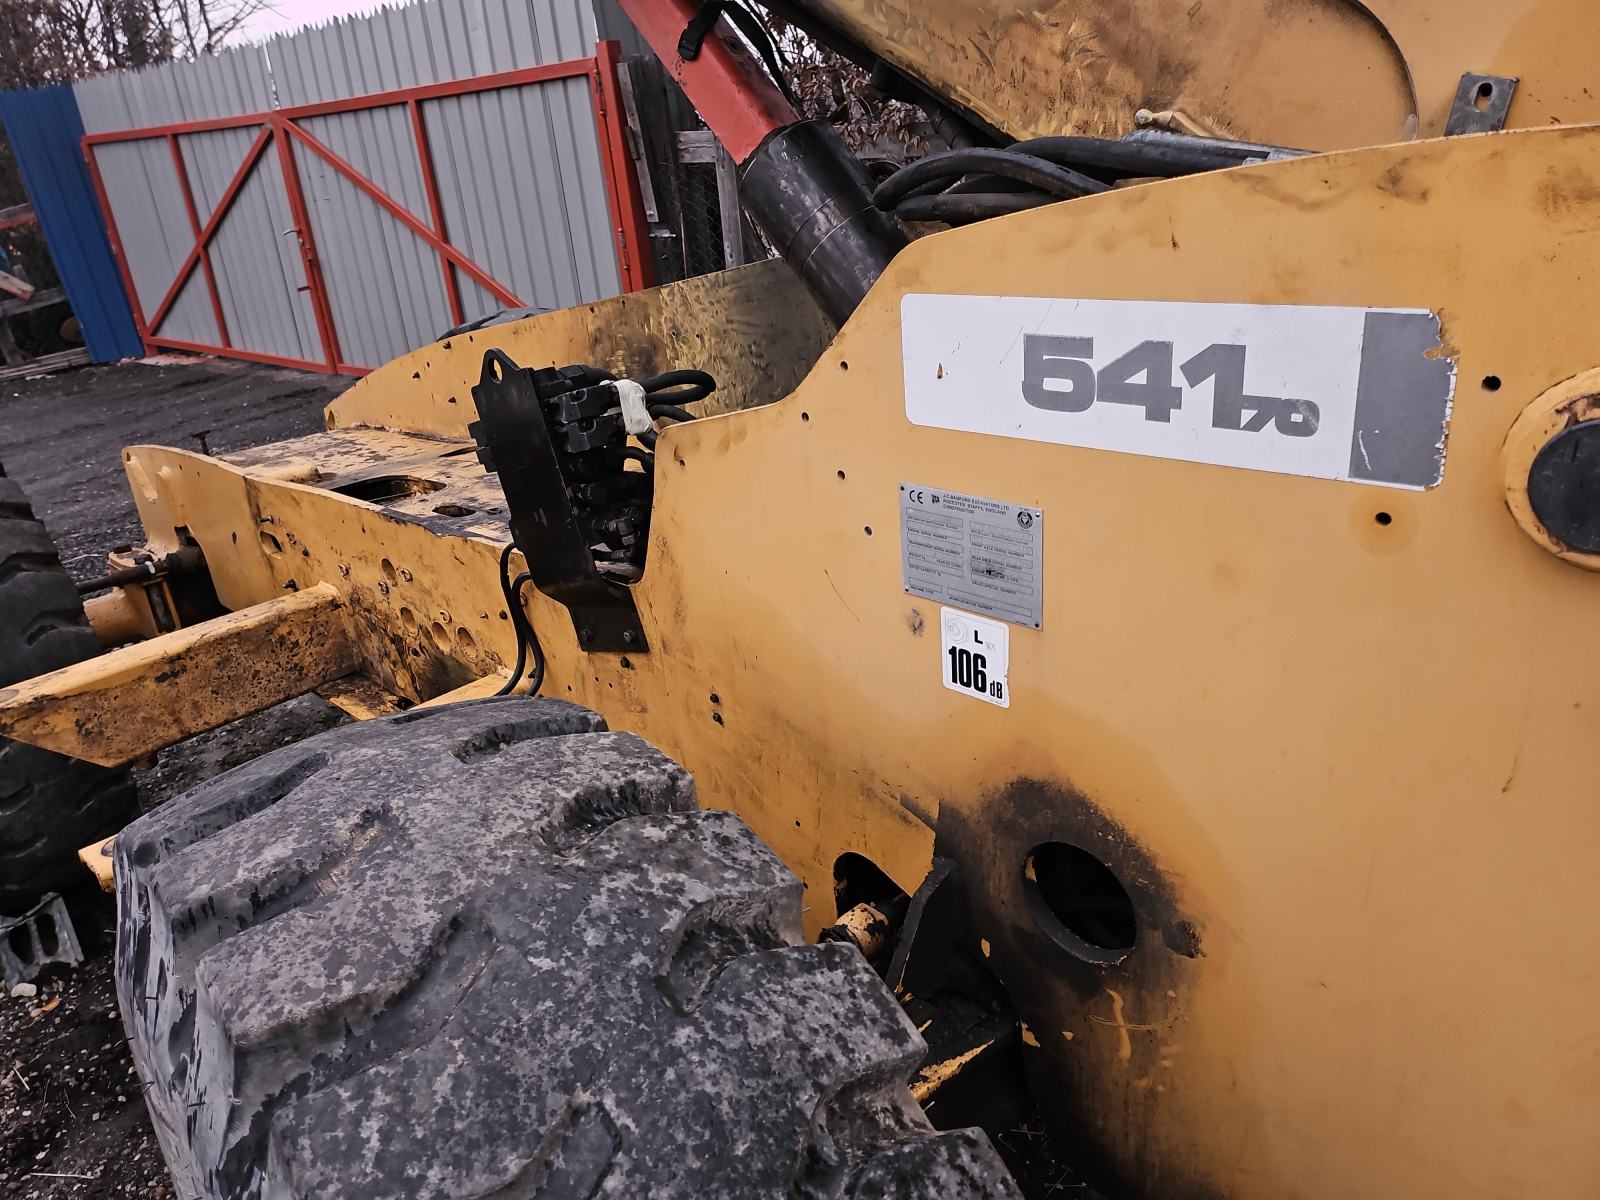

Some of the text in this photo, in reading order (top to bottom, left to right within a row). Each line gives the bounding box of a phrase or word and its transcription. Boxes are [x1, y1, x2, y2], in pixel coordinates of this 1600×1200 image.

[974, 630, 983, 645] L
[948, 646, 1003, 700] 106 dB
